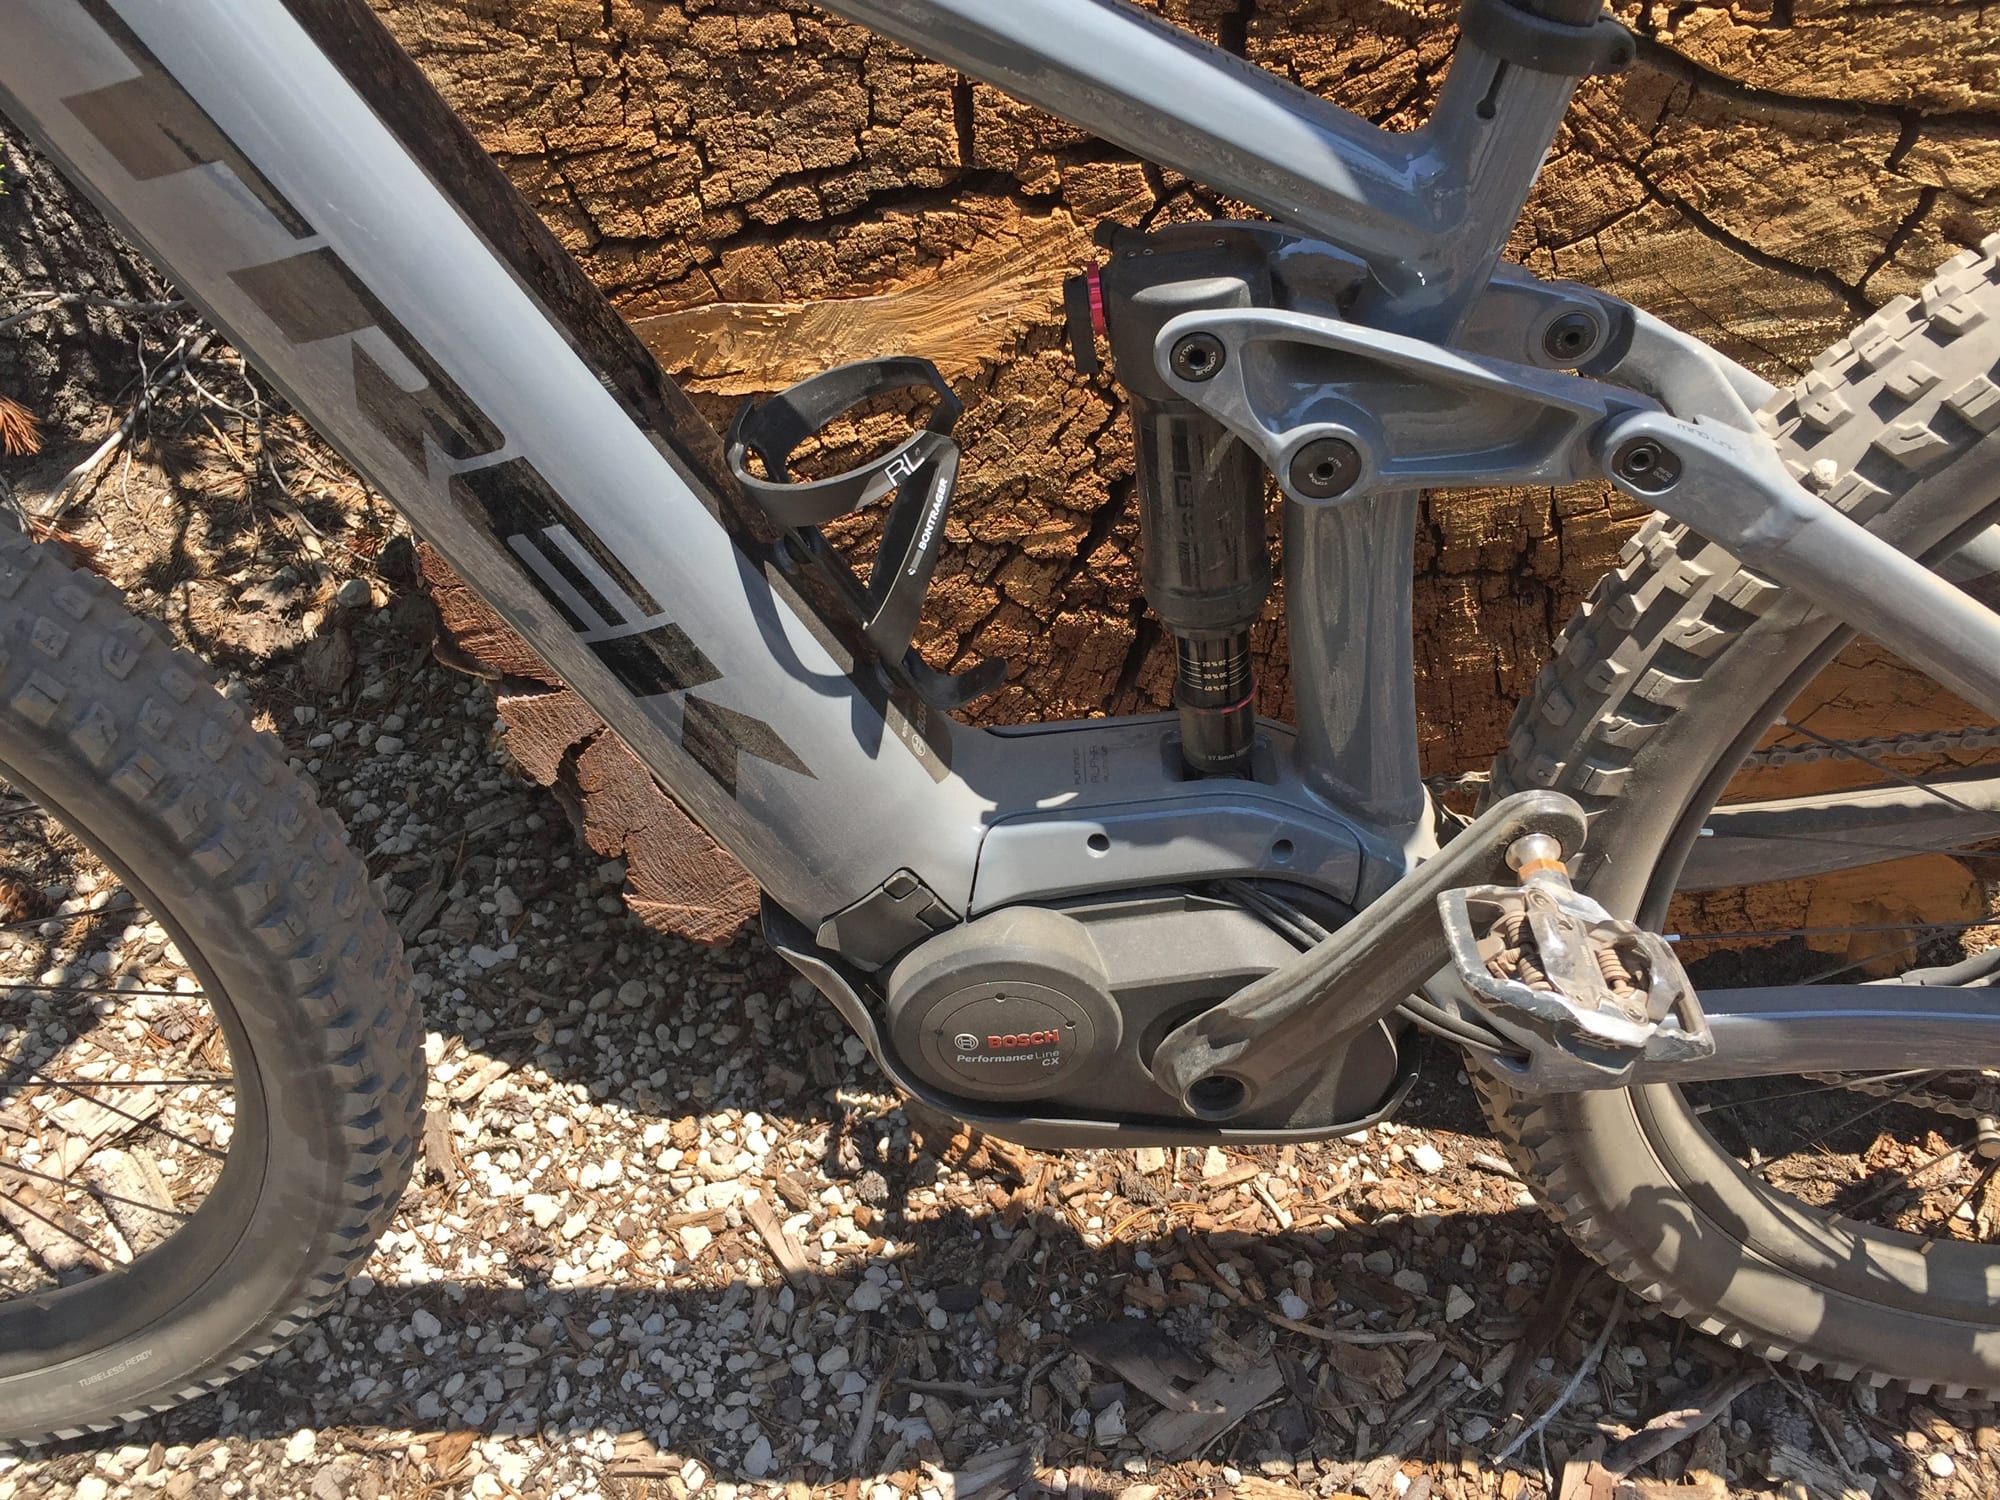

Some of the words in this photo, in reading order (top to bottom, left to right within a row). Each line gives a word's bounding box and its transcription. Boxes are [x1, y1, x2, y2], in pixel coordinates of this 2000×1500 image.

[60, 0, 820, 801] TREK
[884, 452, 925, 487] RL
[918, 477, 948, 551] BONTRAGER
[987, 1028, 1060, 1049] BOSCH
[956, 1053, 1034, 1063] Performance
[1034, 1050, 1060, 1060] Line
[1042, 1057, 1060, 1067] CX
[77, 1363, 126, 1388] TUBELESS
[125, 1349, 153, 1368] READY
